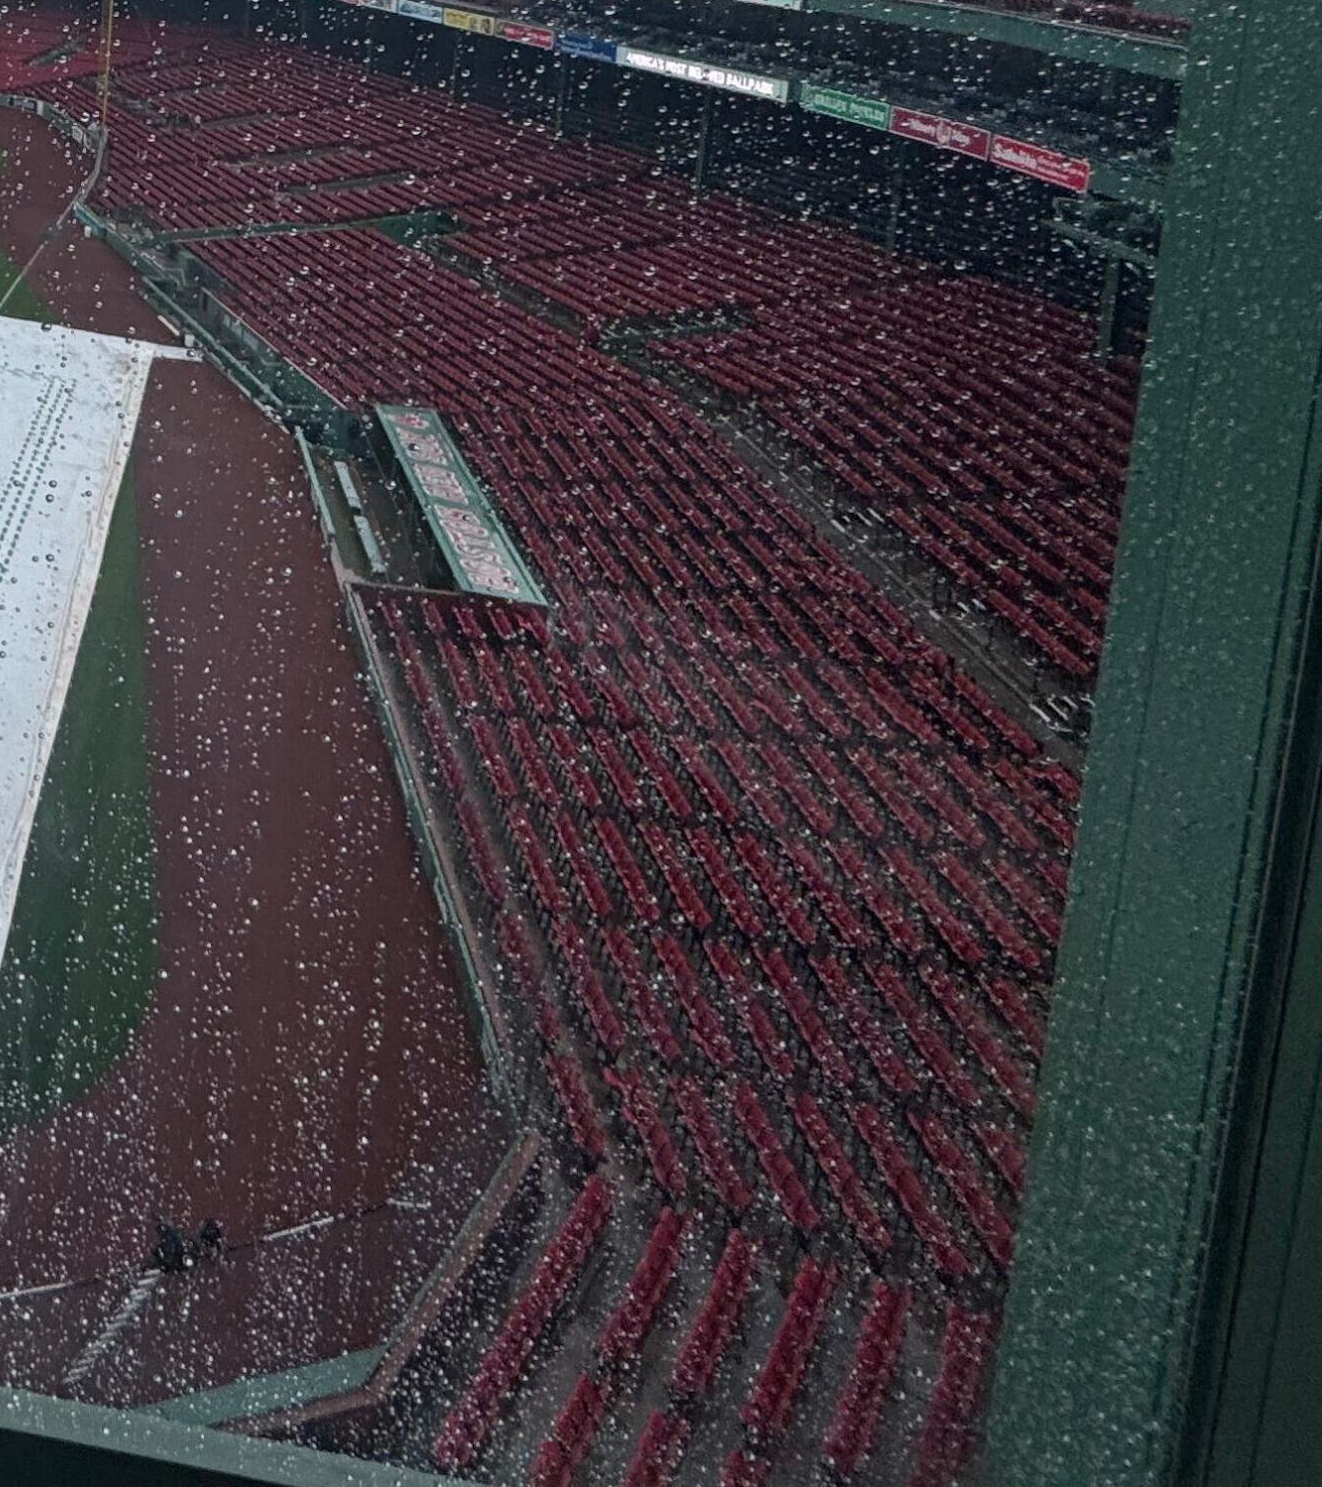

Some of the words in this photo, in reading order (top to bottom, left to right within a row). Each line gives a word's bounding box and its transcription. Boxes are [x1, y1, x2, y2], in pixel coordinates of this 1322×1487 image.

[626, 52, 665, 71] AMERICA'S
[665, 60, 688, 75] MOST
[726, 71, 774, 96] BALLPARK
